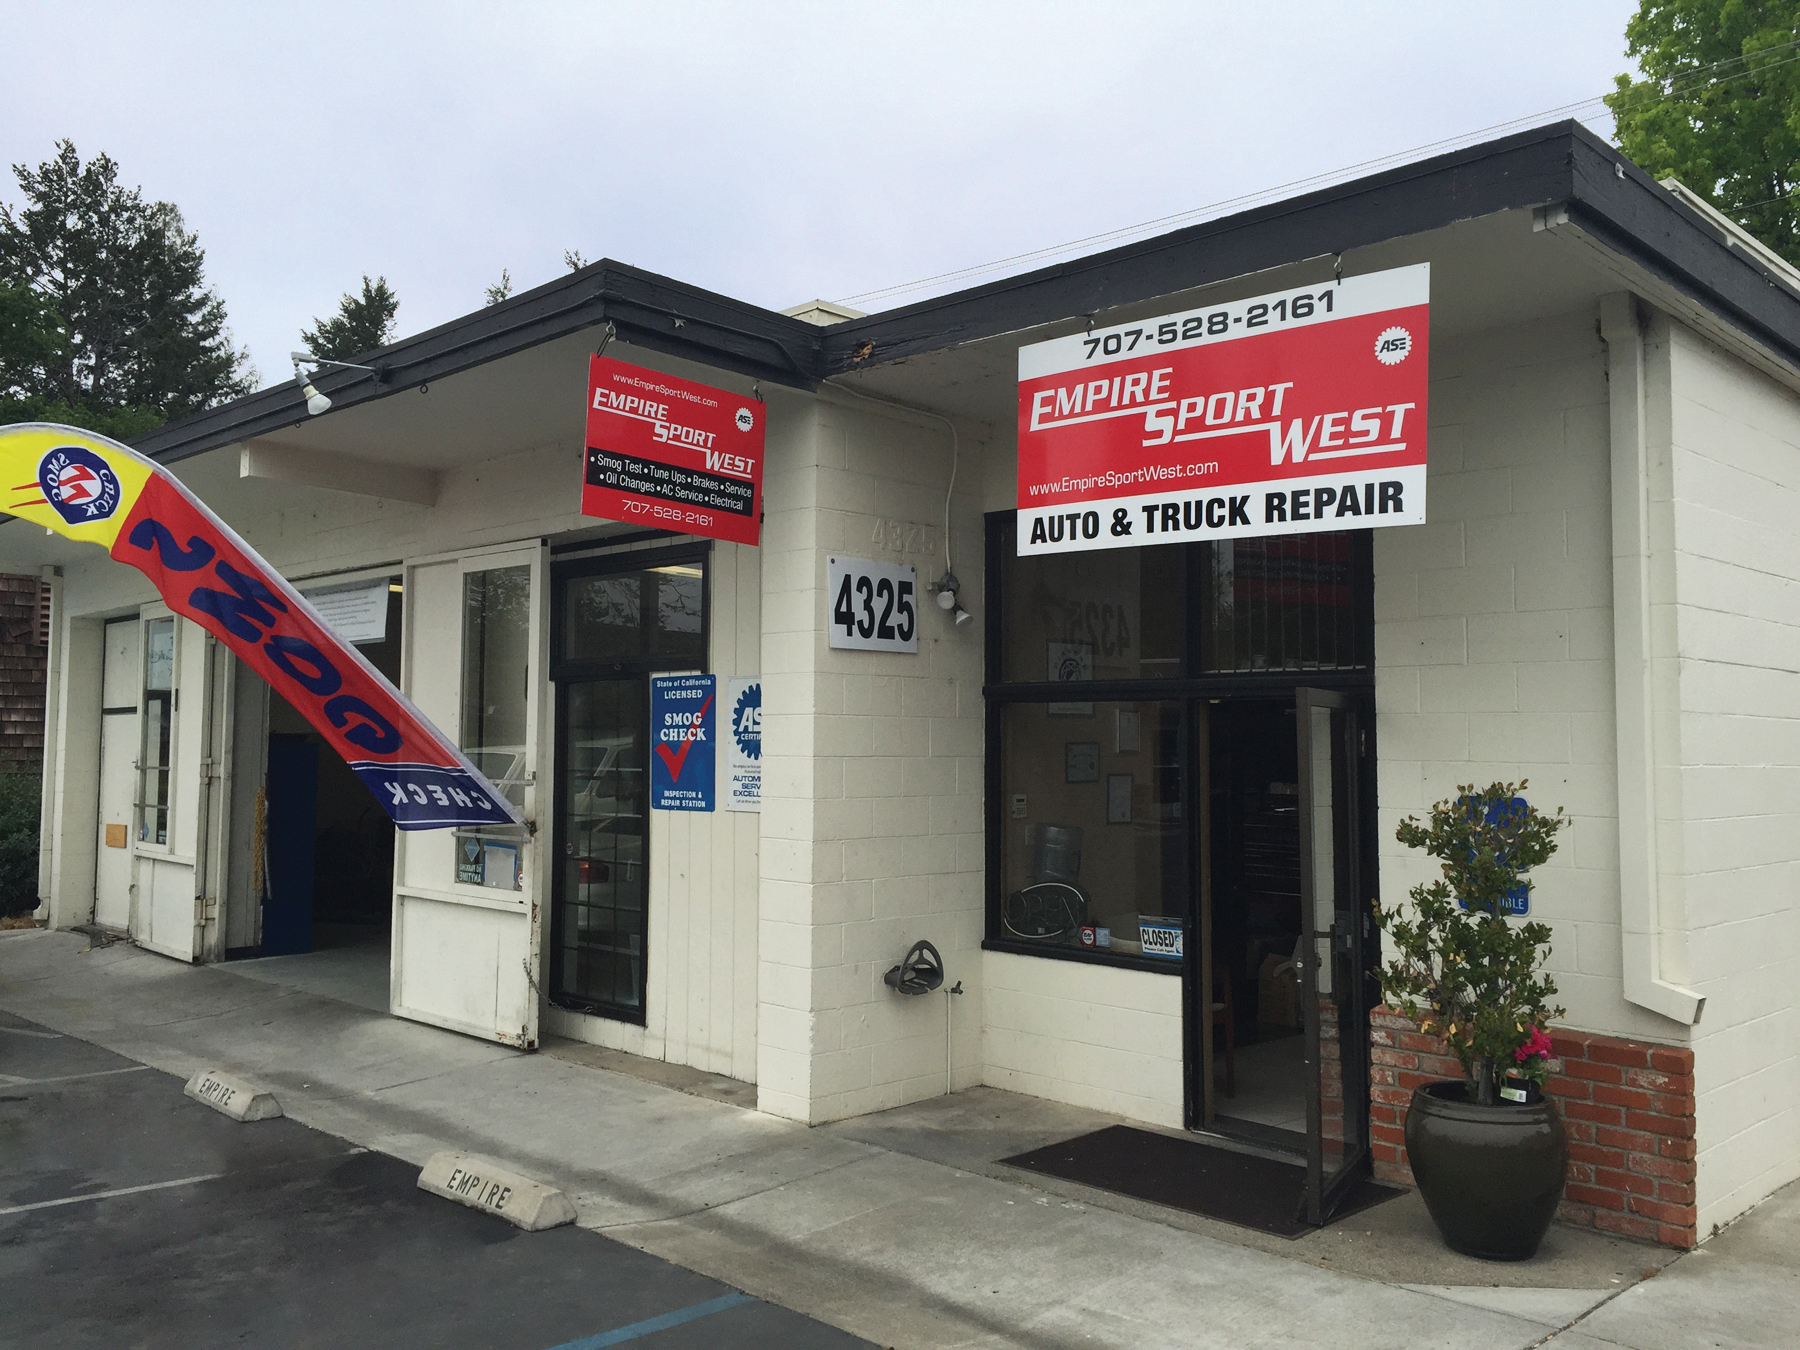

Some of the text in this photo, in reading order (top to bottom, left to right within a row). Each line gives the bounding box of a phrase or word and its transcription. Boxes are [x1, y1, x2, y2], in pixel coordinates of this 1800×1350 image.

[1083, 289, 1334, 360] 707-528-2161
[1378, 337, 1407, 353] ASE
[592, 387, 669, 421] EMPIRE
[612, 373, 718, 408] www.EmpireSportWest.com
[1030, 367, 1173, 432] EMPIRE
[737, 414, 751, 426] ASE
[1142, 382, 1293, 447] SPORT
[653, 421, 716, 448] SPORT
[1269, 402, 1415, 466] WEST
[706, 449, 755, 473] WEST
[597, 454, 752, 498] Smog Test Tune Ups Brakes Service
[1029, 460, 1219, 496] www.EmpireSportWest.com
[605, 472, 744, 511] Oil Changes AC Service Electrical
[622, 499, 714, 527] 707-528-2161
[1030, 480, 1404, 545] AUTO & TRUCK REPAIR
[834, 573, 915, 642] 4325
[656, 680, 673, 688] State
[681, 678, 711, 687] California
[664, 689, 703, 700] LICENSED
[664, 712, 703, 726] SMOG
[738, 706, 762, 732] AS
[660, 728, 707, 741] CHECK
[661, 798, 706, 808] REPAIR STATION
[663, 790, 696, 798] INSPECTION
[1142, 928, 1175, 948] CLOSED
[199, 1078, 237, 1107] EMPIRE
[446, 1168, 512, 1211] EMPIRE
